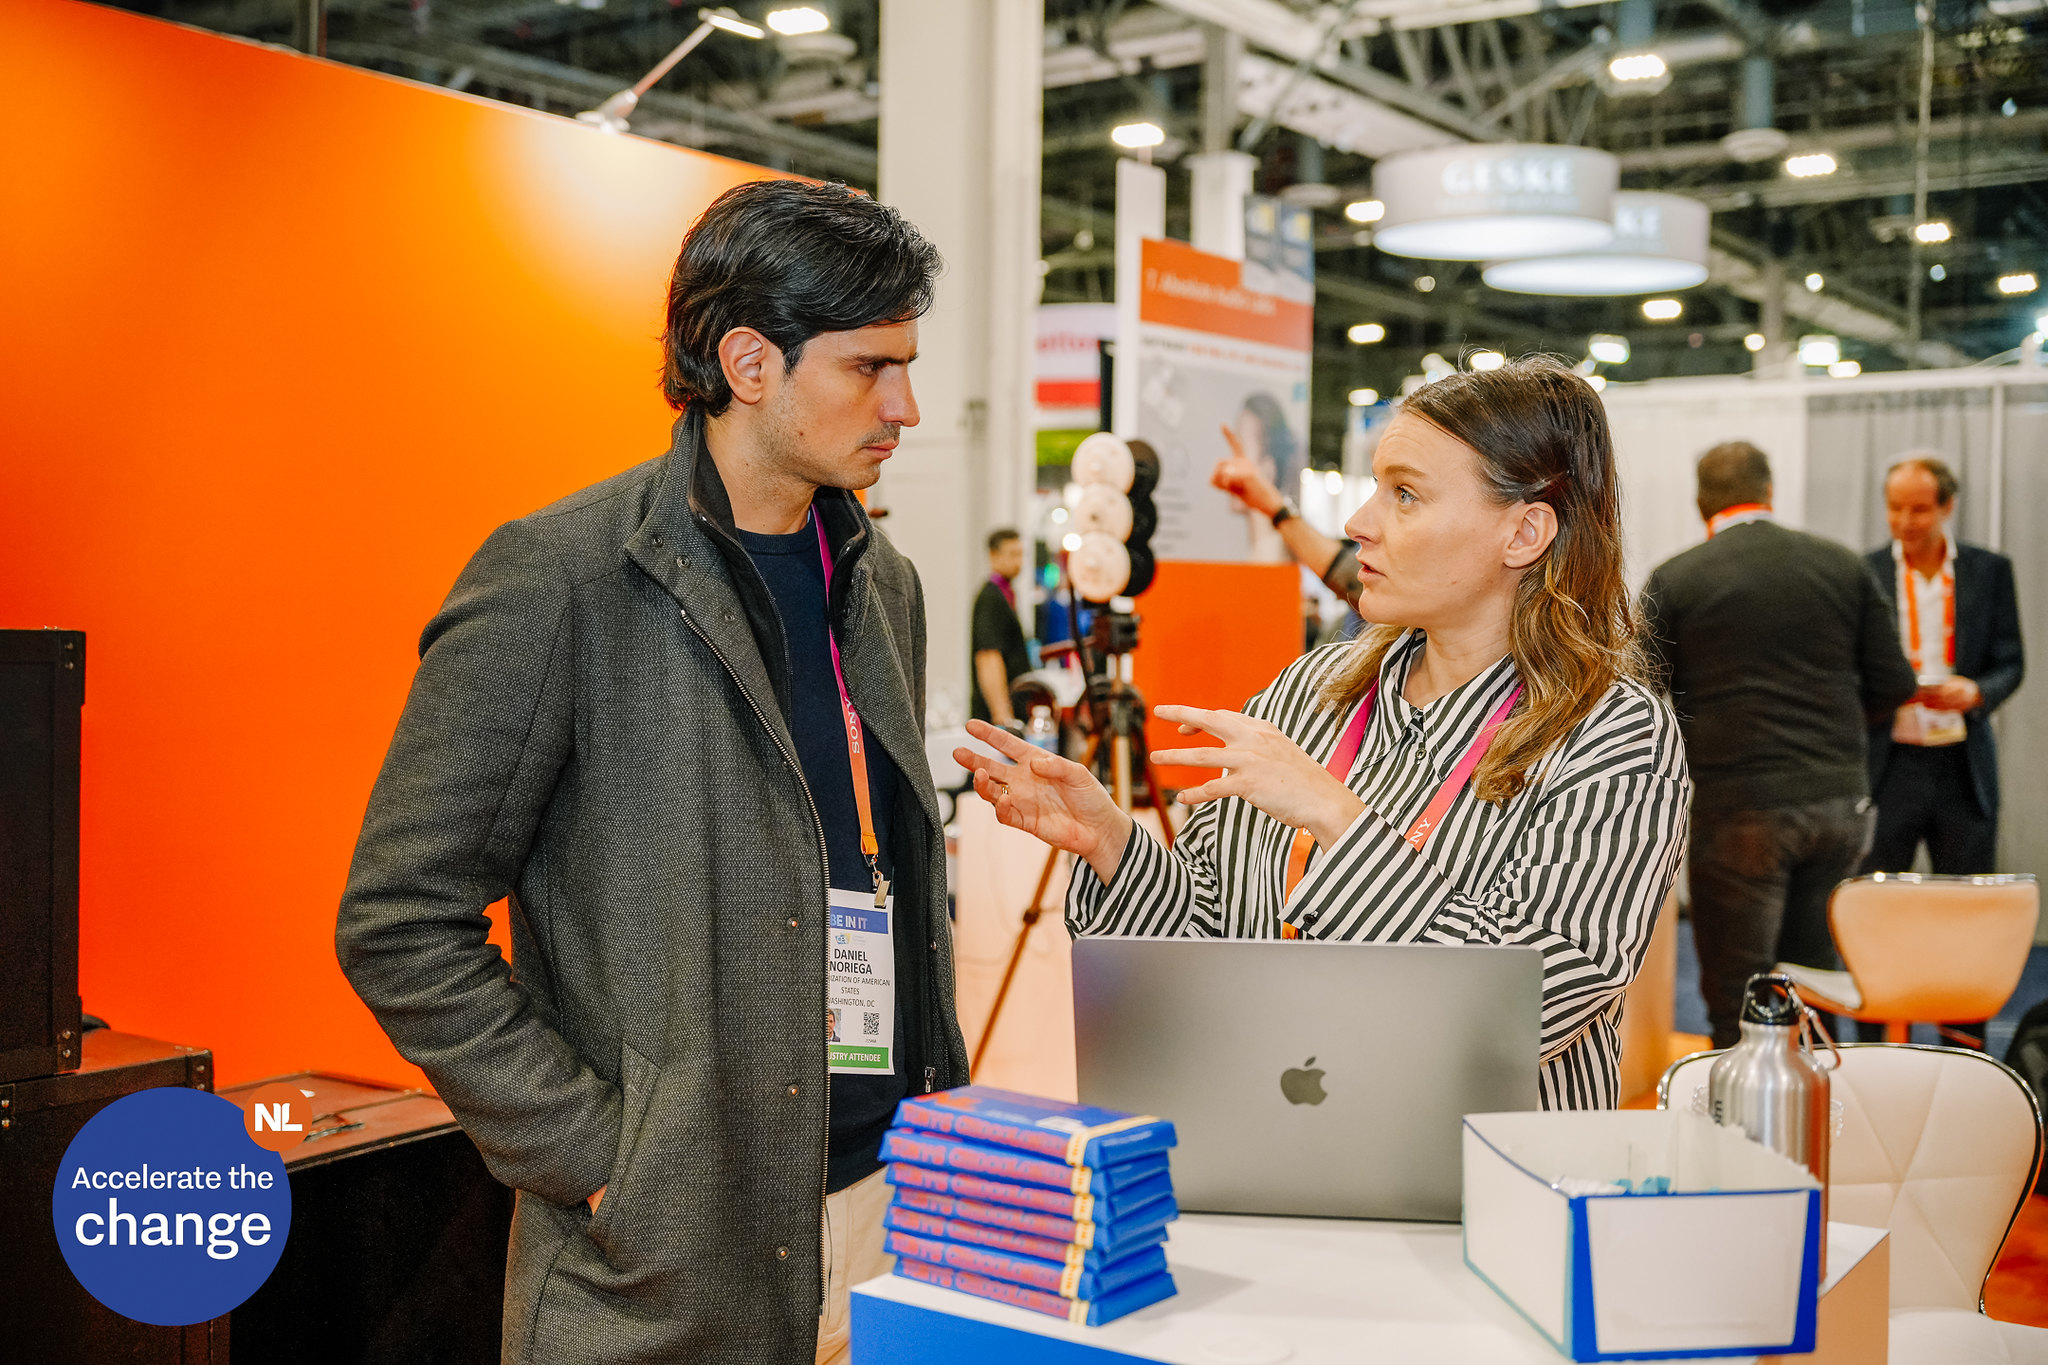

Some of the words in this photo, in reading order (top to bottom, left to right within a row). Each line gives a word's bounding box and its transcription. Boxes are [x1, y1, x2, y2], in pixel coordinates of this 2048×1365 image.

[844, 696, 861, 754] SONY
[1408, 817, 1431, 845] NY
[845, 915, 856, 929] IN
[858, 917, 868, 930] IT
[834, 948, 868, 962] DANIEL
[829, 961, 873, 975] NORIEGA
[829, 975, 852, 983] IZATION
[852, 976, 861, 984] OF
[861, 978, 890, 986] AMERICAN
[841, 986, 860, 995] STATES
[828, 1051, 849, 1061] USTRY
[849, 1053, 881, 1062] ATTENDEE
